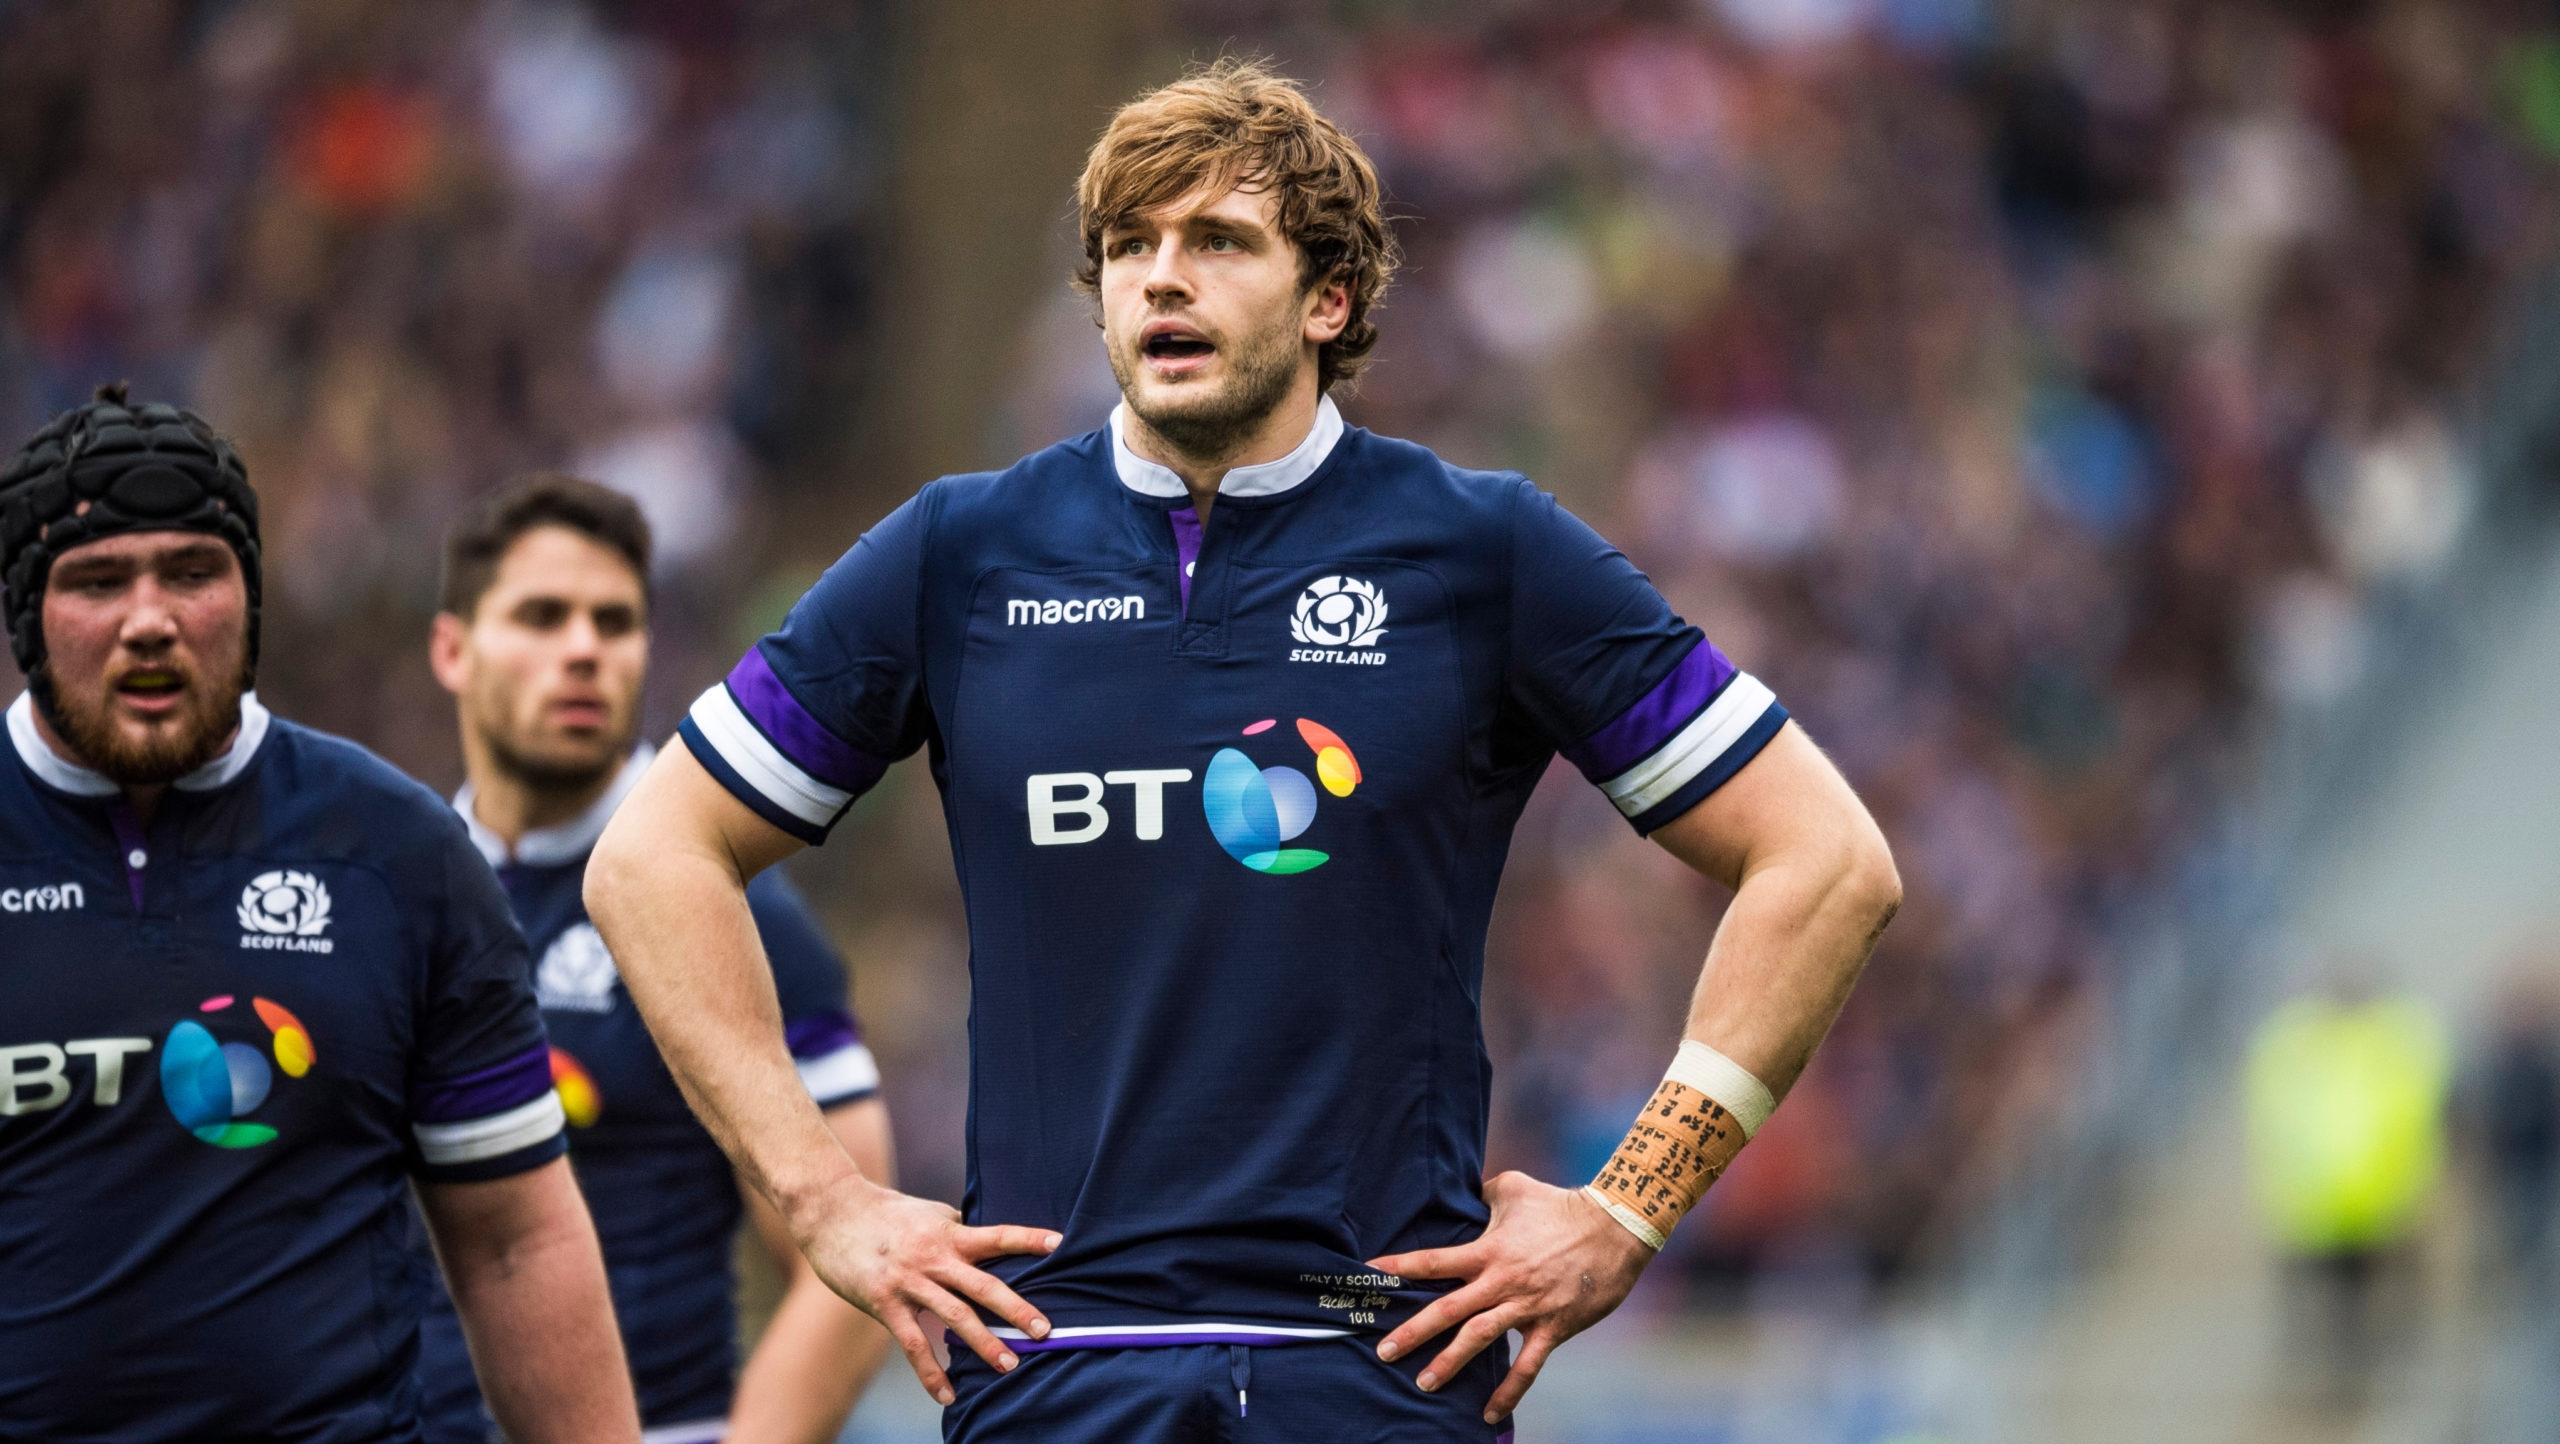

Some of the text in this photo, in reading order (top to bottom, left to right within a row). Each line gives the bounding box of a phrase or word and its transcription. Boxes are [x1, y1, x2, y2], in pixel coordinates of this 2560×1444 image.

[1007, 596, 1145, 625] macron
[1290, 648, 1386, 665] SCOTLAND
[1027, 768, 1192, 845] BT
[241, 935, 333, 953] SCOTLAND
[0, 1038, 151, 1115] BT
[1300, 1274, 1400, 1287] ITALY V SCOTLAND
[1348, 1312, 1375, 1324] 1018
